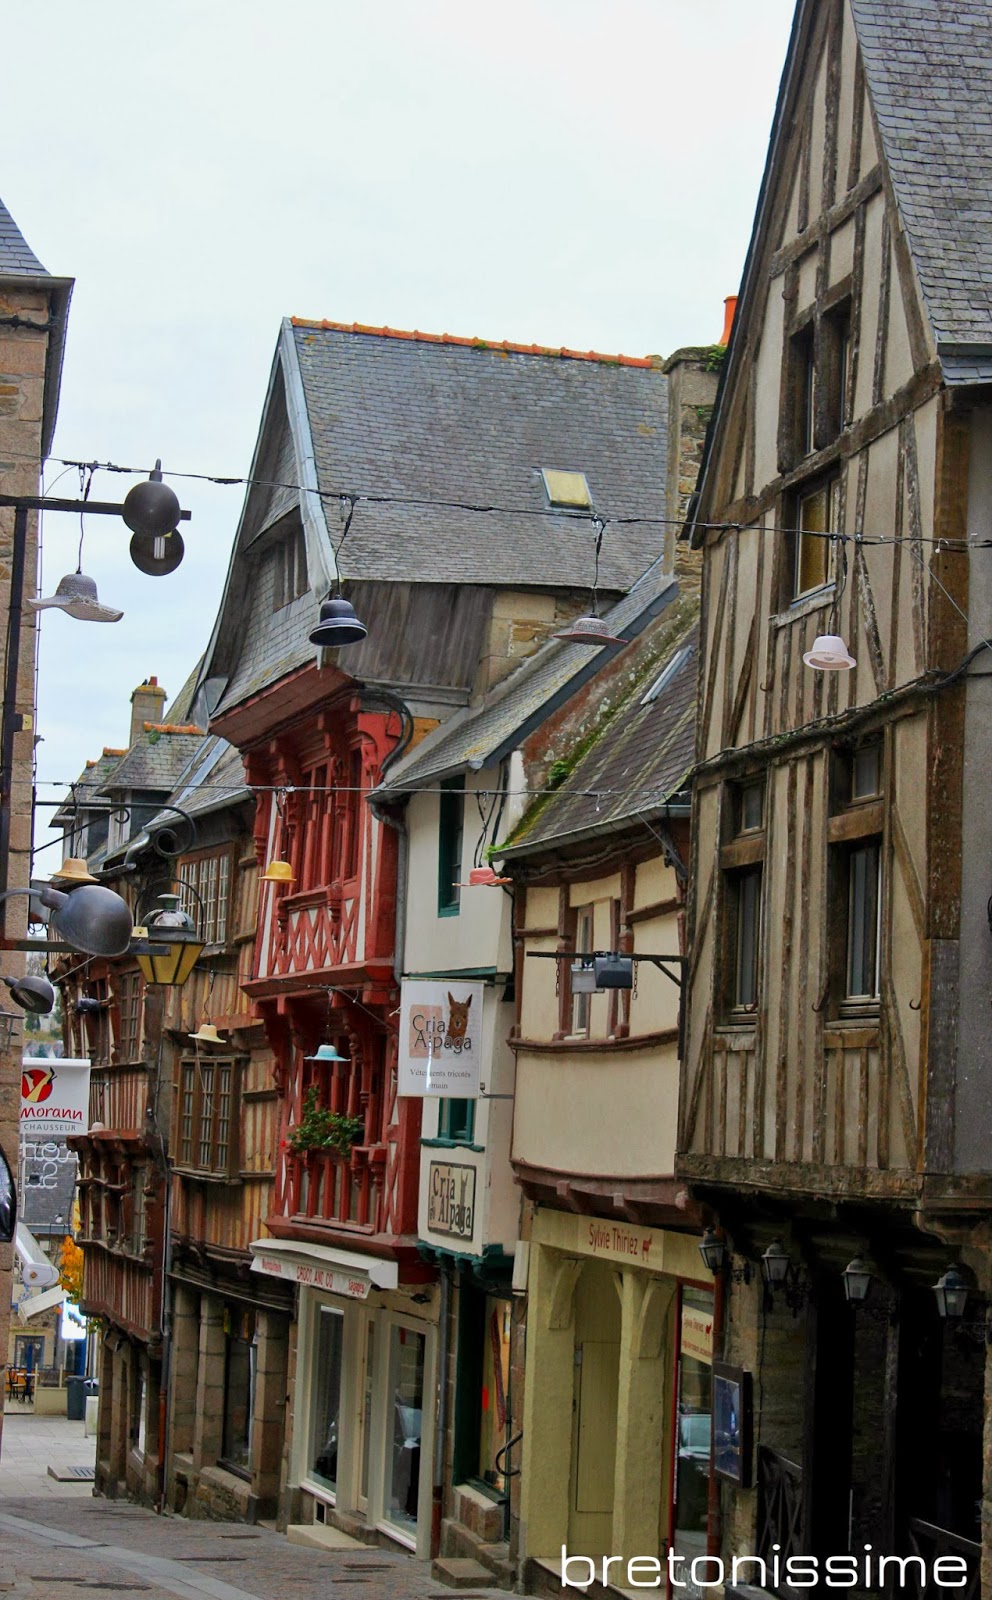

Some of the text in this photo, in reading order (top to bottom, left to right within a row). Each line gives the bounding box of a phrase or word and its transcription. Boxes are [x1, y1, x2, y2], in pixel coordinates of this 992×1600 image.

[412, 1014, 446, 1033] Cria
[410, 1068, 446, 1077] Vêteents
[23, 1123, 77, 1132] CHAUSSEUR
[433, 1167, 456, 1200] Cria
[437, 1195, 471, 1234] Alpaga
[589, 1223, 638, 1255] Sylvie Thiriez
